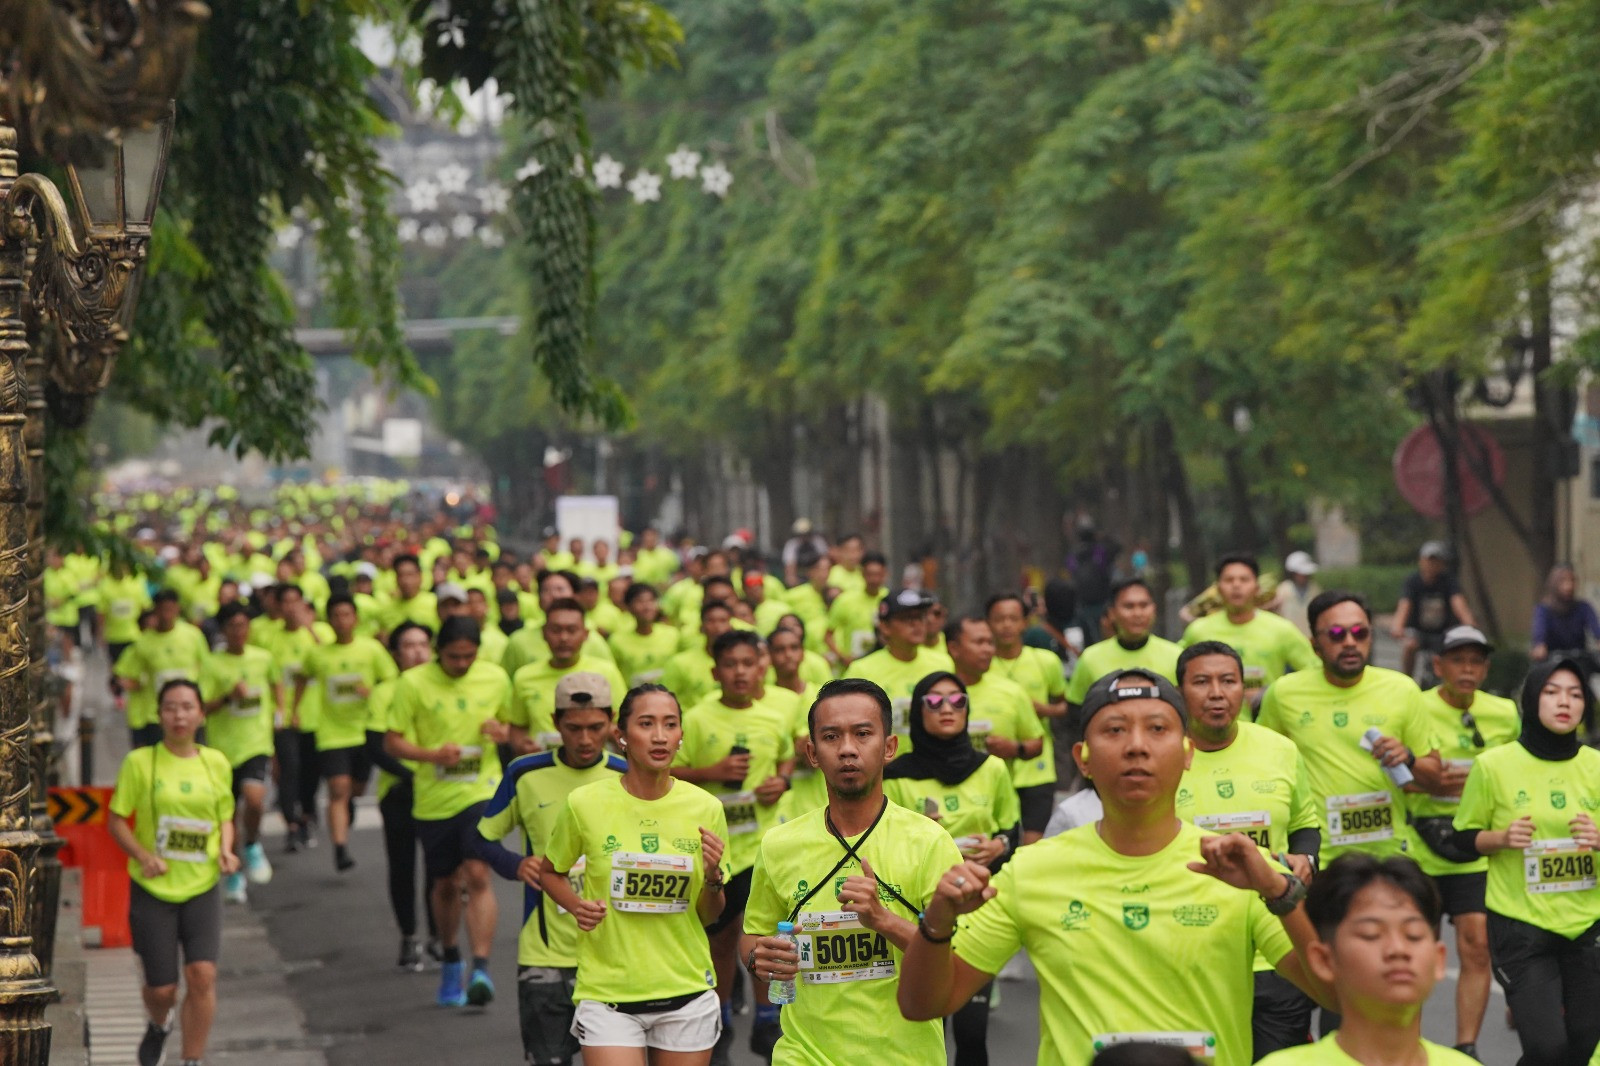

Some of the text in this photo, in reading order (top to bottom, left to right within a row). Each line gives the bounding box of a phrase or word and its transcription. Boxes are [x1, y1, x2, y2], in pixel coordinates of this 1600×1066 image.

[1342, 807, 1392, 831] 50583
[1542, 854, 1594, 878] 52418
[613, 876, 624, 892] 5K
[626, 872, 690, 898] 52527
[801, 942, 811, 962] 5K
[816, 933, 888, 964] 50154
